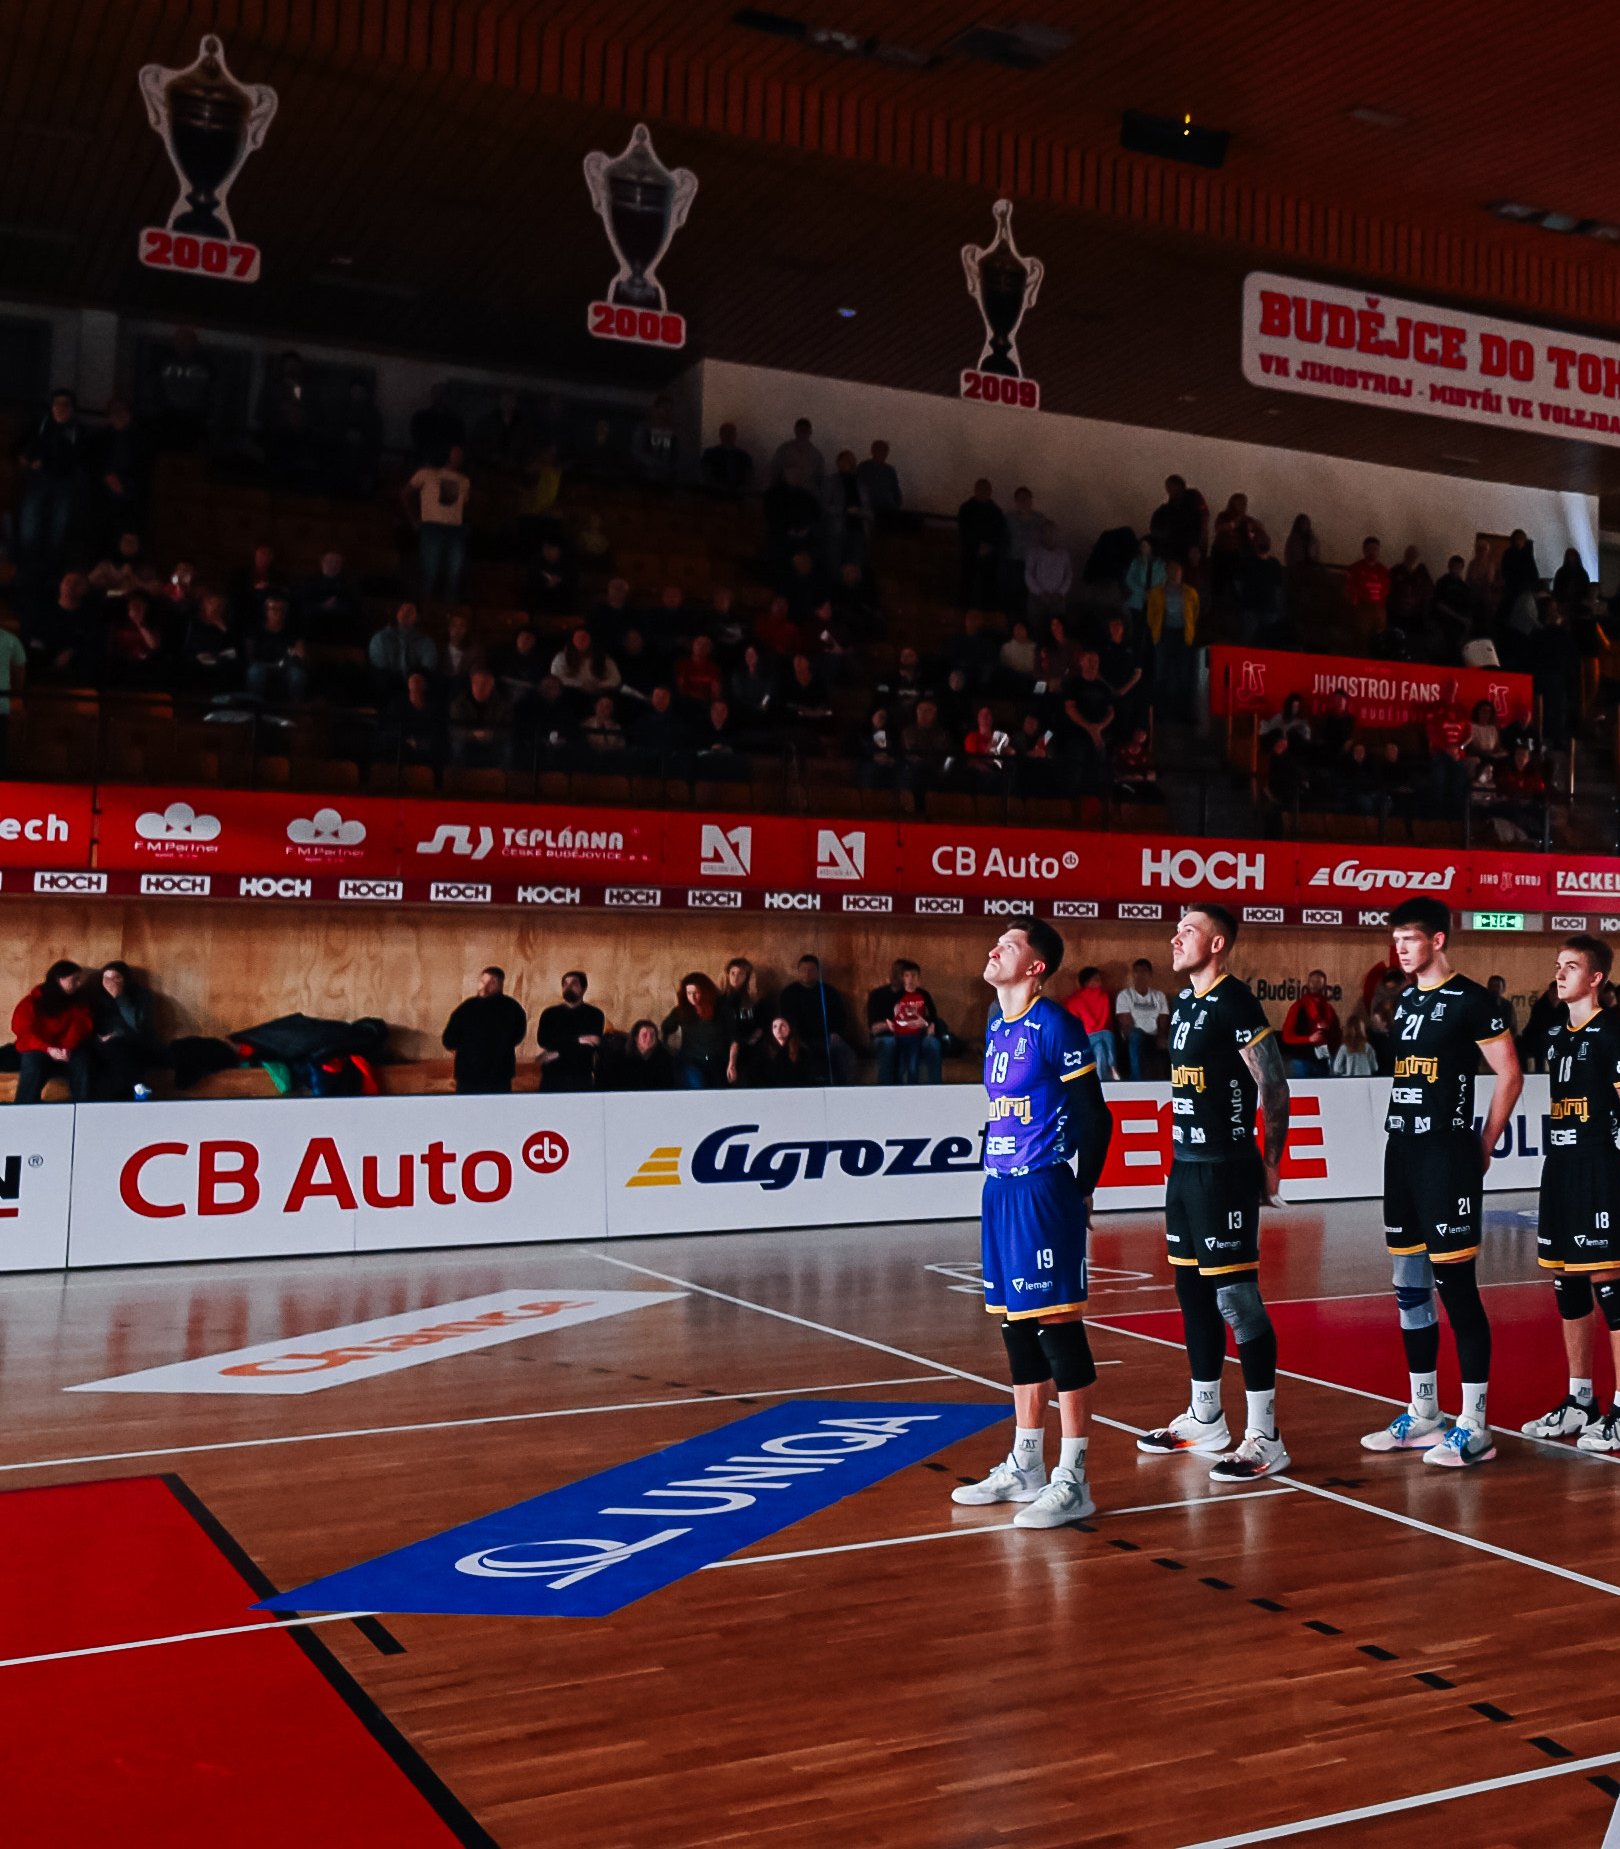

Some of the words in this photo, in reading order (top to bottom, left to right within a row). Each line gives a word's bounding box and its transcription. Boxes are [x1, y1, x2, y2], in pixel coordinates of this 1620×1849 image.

[144, 232, 257, 278] 2007
[592, 304, 683, 346] 2008
[1259, 290, 1468, 372] BUDĚJCE
[1479, 334, 1535, 382] DO
[963, 372, 1038, 408] 2009
[1259, 353, 1289, 378] VK
[1295, 358, 1413, 401] JIHOSTROJ
[1429, 382, 1502, 416] MISTŘI
[1509, 395, 1534, 420] VE
[1312, 673, 1397, 702] JIHOSTROJ
[1400, 681, 1441, 703] FANS
[0, 814, 69, 842] ech
[147, 842, 163, 851] M
[165, 842, 218, 853] Partner
[298, 847, 313, 856] M
[932, 846, 977, 876] CB
[983, 848, 1060, 879] Auto
[1142, 848, 1265, 890] HOCH
[40, 874, 102, 891] HOCH
[1333, 860, 1456, 891] Agrozet
[146, 877, 205, 893] HOCH
[239, 877, 312, 897] HOCH
[344, 883, 398, 897] HOCH
[434, 884, 487, 899] HOCH
[517, 886, 580, 904] HOCH
[608, 890, 657, 905] HOCH
[691, 892, 739, 907] HOCH
[765, 893, 821, 910] HOCH
[849, 897, 888, 911] HOCH
[918, 899, 961, 913] HOCH
[984, 900, 1034, 916] HOCH
[1057, 903, 1096, 916] HOCH
[1121, 905, 1159, 918] HOCH
[1246, 908, 1281, 922] HOCH
[1305, 910, 1340, 924] HOCH
[1358, 911, 1390, 925] HOC
[1554, 918, 1584, 930] HOCH
[1172, 1021, 1190, 1051] 13
[1400, 1014, 1425, 1041] 21
[990, 1052, 1009, 1083] 19
[1558, 1055, 1573, 1083] 18
[118, 1141, 261, 1219] CB
[283, 1137, 513, 1214] Auto
[1457, 1196, 1471, 1216] 21
[1228, 1210, 1243, 1230] 13
[1448, 1223, 1471, 1234] leman
[1595, 1211, 1609, 1230] 18
[1216, 1237, 1242, 1249] leman
[1585, 1237, 1609, 1247] leman
[1036, 1248, 1054, 1270] 19
[1025, 1279, 1053, 1291] leman
[599, 1414, 943, 1517] UNIQA
